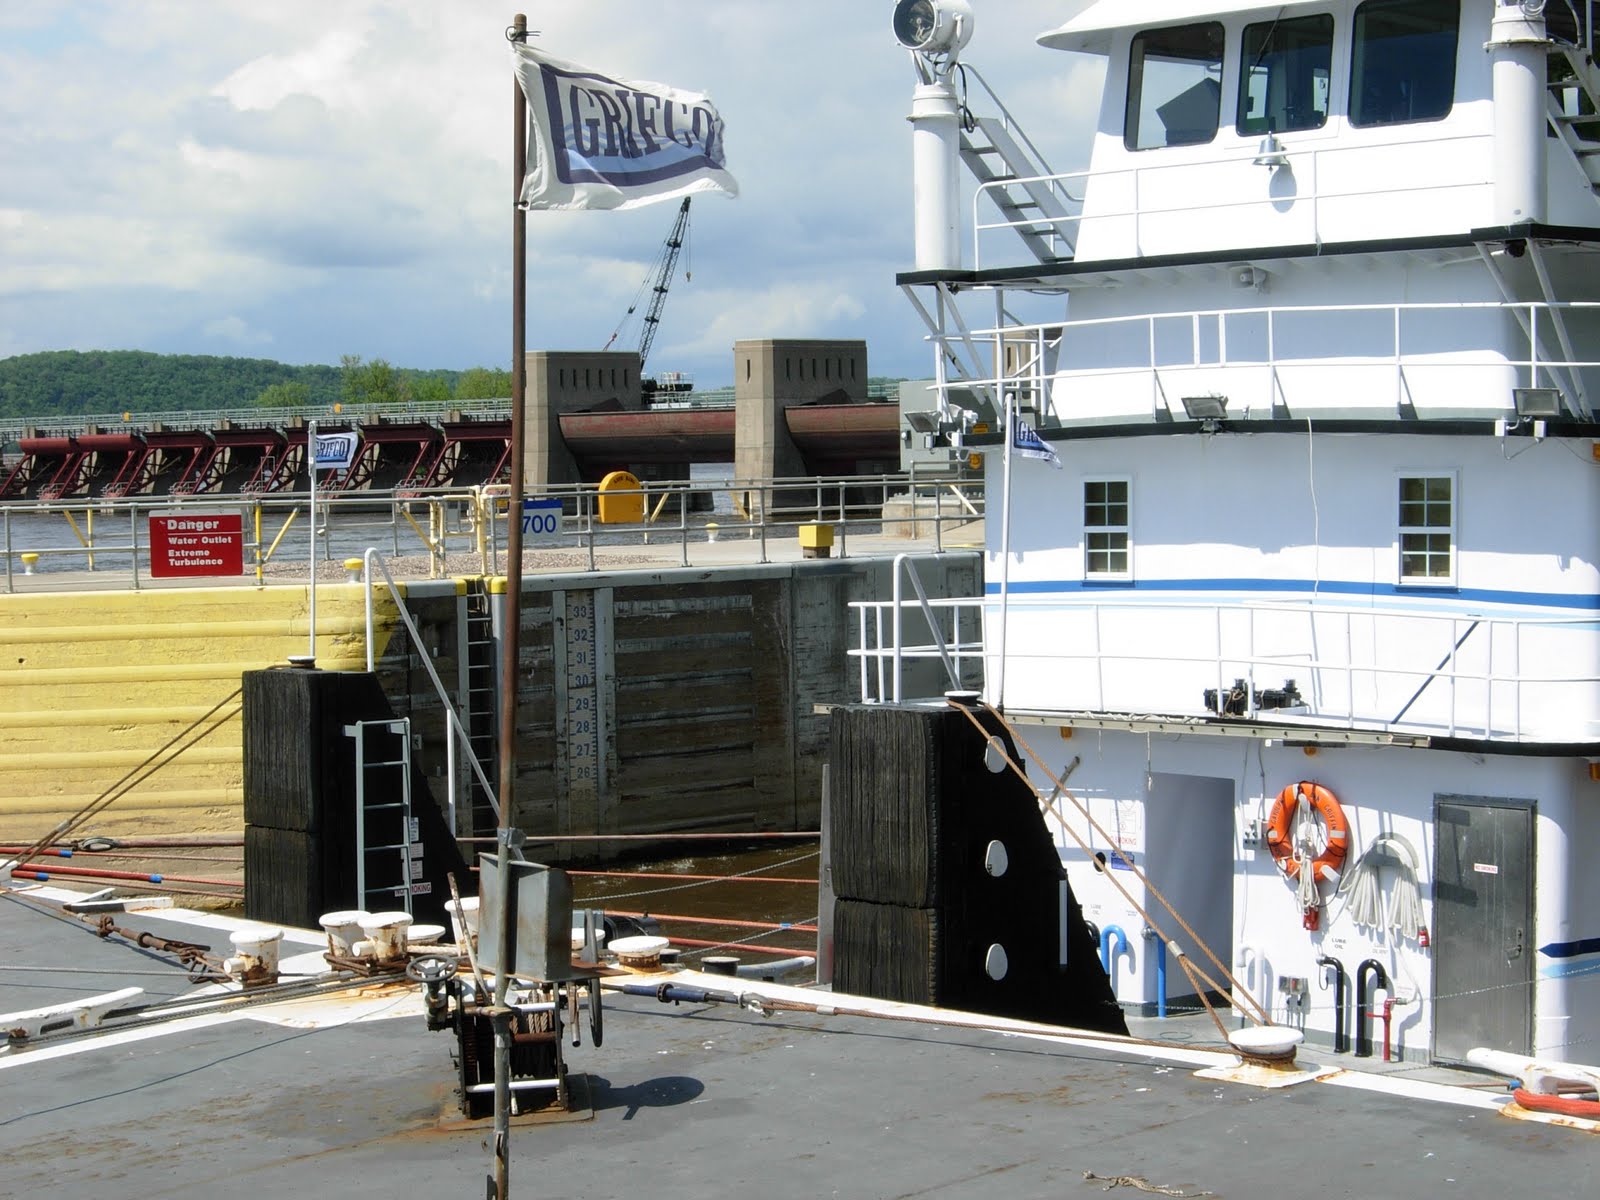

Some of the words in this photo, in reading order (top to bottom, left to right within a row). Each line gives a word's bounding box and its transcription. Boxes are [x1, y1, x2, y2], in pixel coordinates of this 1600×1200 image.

[569, 84, 715, 159] GRIFCO
[167, 519, 219, 531] Danger
[201, 536, 232, 544] Outlet
[168, 549, 210, 557] Extreme
[169, 558, 223, 566] Turbulence
[573, 606, 587, 618] 33
[574, 629, 588, 641] 32
[576, 652, 587, 664] 31
[575, 675, 589, 687] 30
[576, 698, 589, 710] 29
[576, 720, 590, 733] 28
[576, 743, 590, 756] 27
[577, 767, 590, 779] 26
